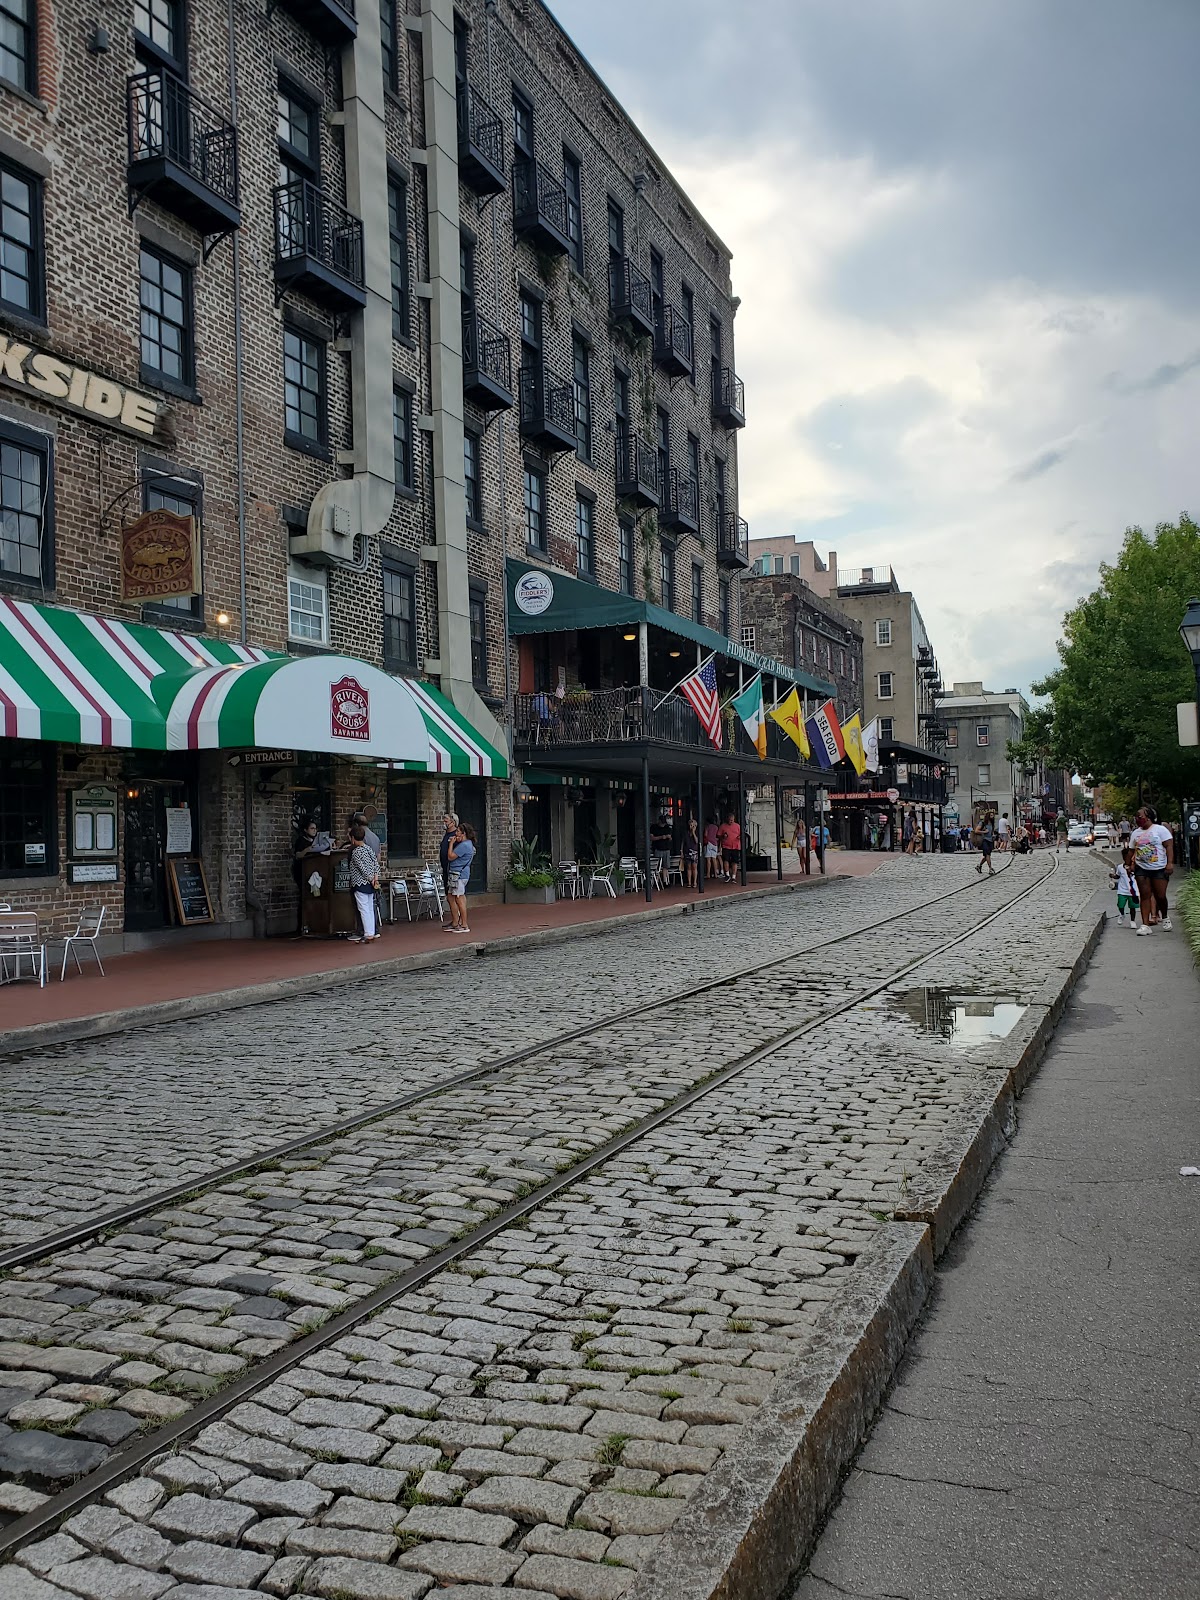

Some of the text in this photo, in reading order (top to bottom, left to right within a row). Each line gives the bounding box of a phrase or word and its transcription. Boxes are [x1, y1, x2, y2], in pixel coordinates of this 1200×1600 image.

[129, 529, 184, 551] RIVER
[131, 560, 182, 580] HOUSE
[128, 581, 189, 597] SEAFOOD
[759, 655, 775, 671] CRAB
[776, 663, 794, 679] HOUSE
[336, 692, 364, 707] RIVER
[337, 711, 364, 728] HOUSE
[334, 728, 368, 738] SAVANNAH
[818, 716, 837, 756] SEA FOOD
[245, 751, 292, 762] ENTRANCE
